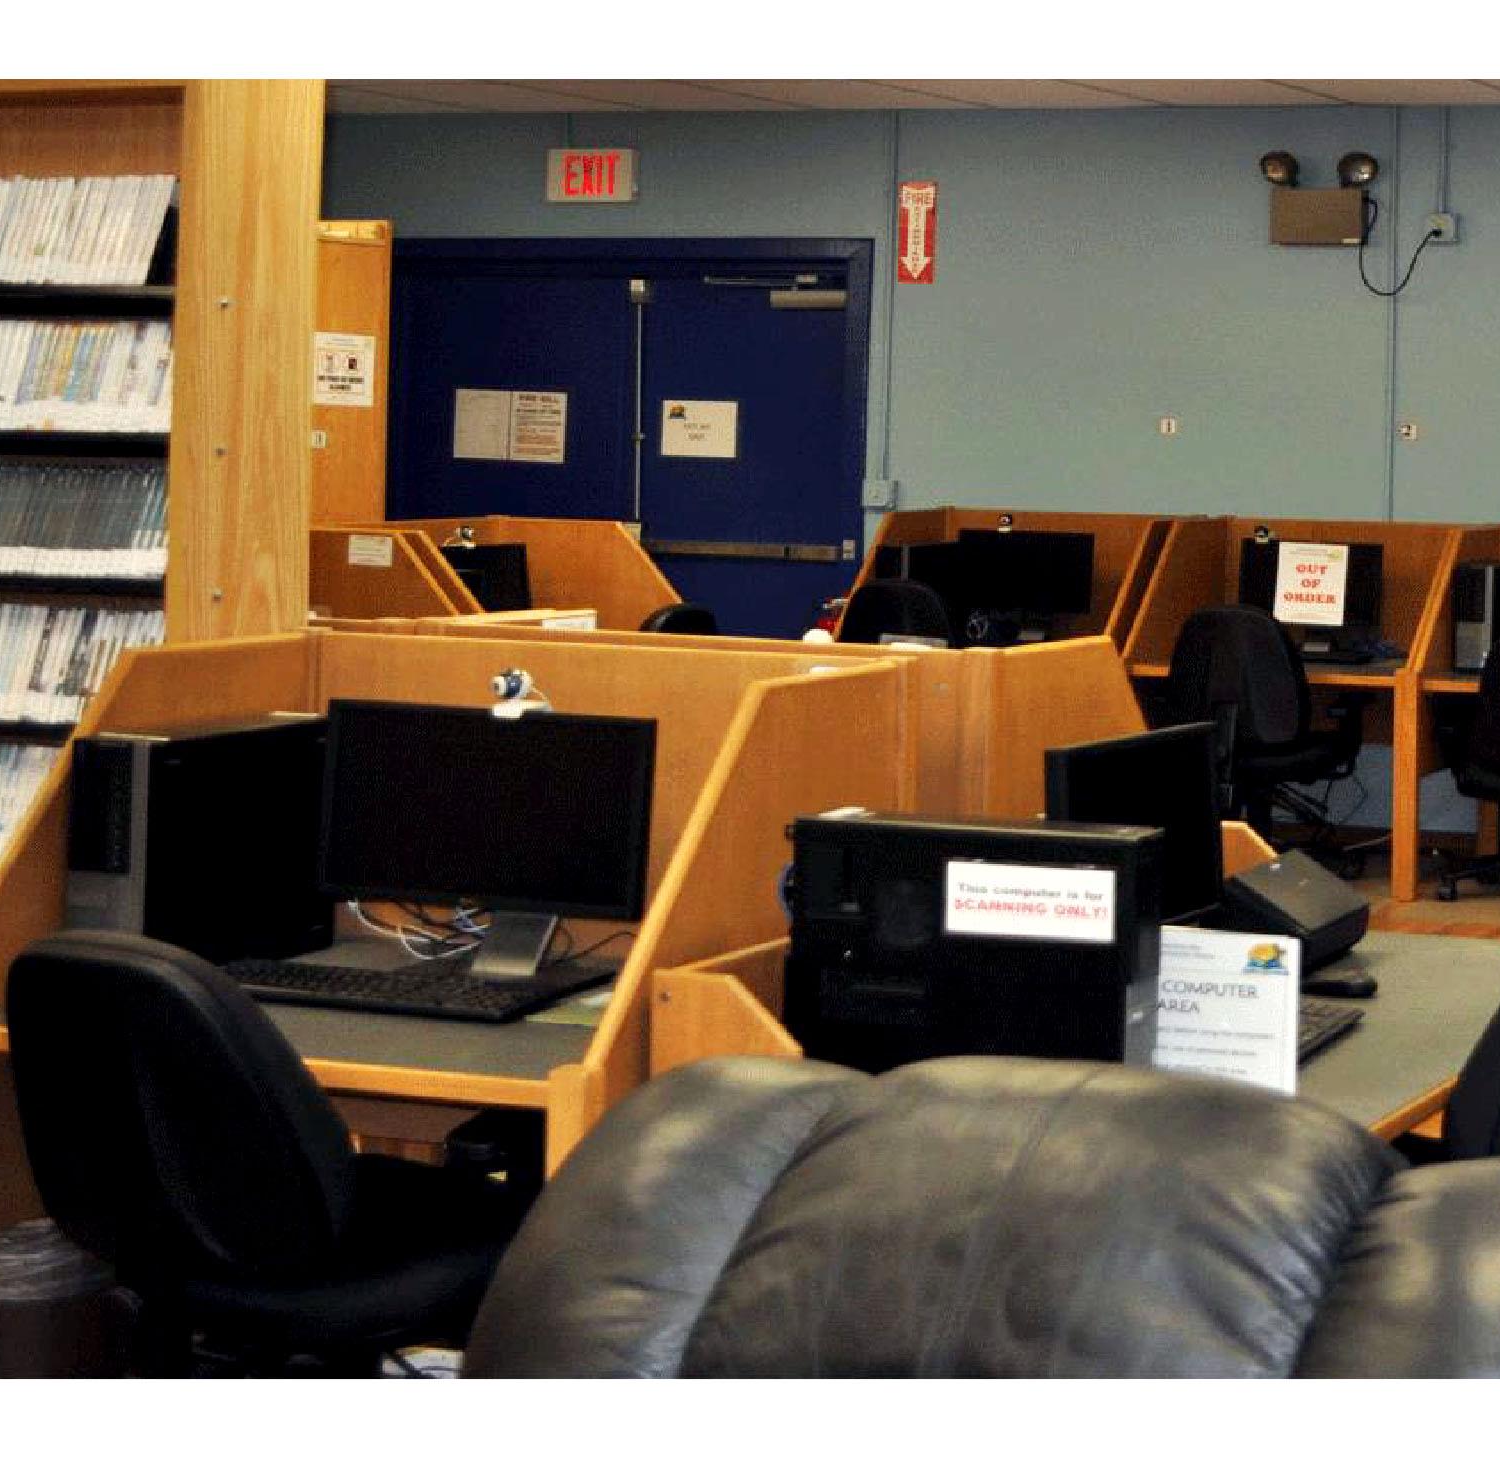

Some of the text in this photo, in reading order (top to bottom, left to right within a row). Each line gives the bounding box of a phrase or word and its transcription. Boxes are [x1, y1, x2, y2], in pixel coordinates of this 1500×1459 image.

[564, 151, 621, 197] EXIT
[903, 191, 933, 206] FIRE
[1296, 564, 1328, 575] OUT
[1301, 578, 1321, 589] OF
[1283, 592, 1337, 604] ORDER
[959, 882, 1104, 901] This computer is for
[954, 899, 1048, 915] SCANNING
[1161, 978, 1260, 999] COMPUTER
[1156, 998, 1200, 1015] AREA
